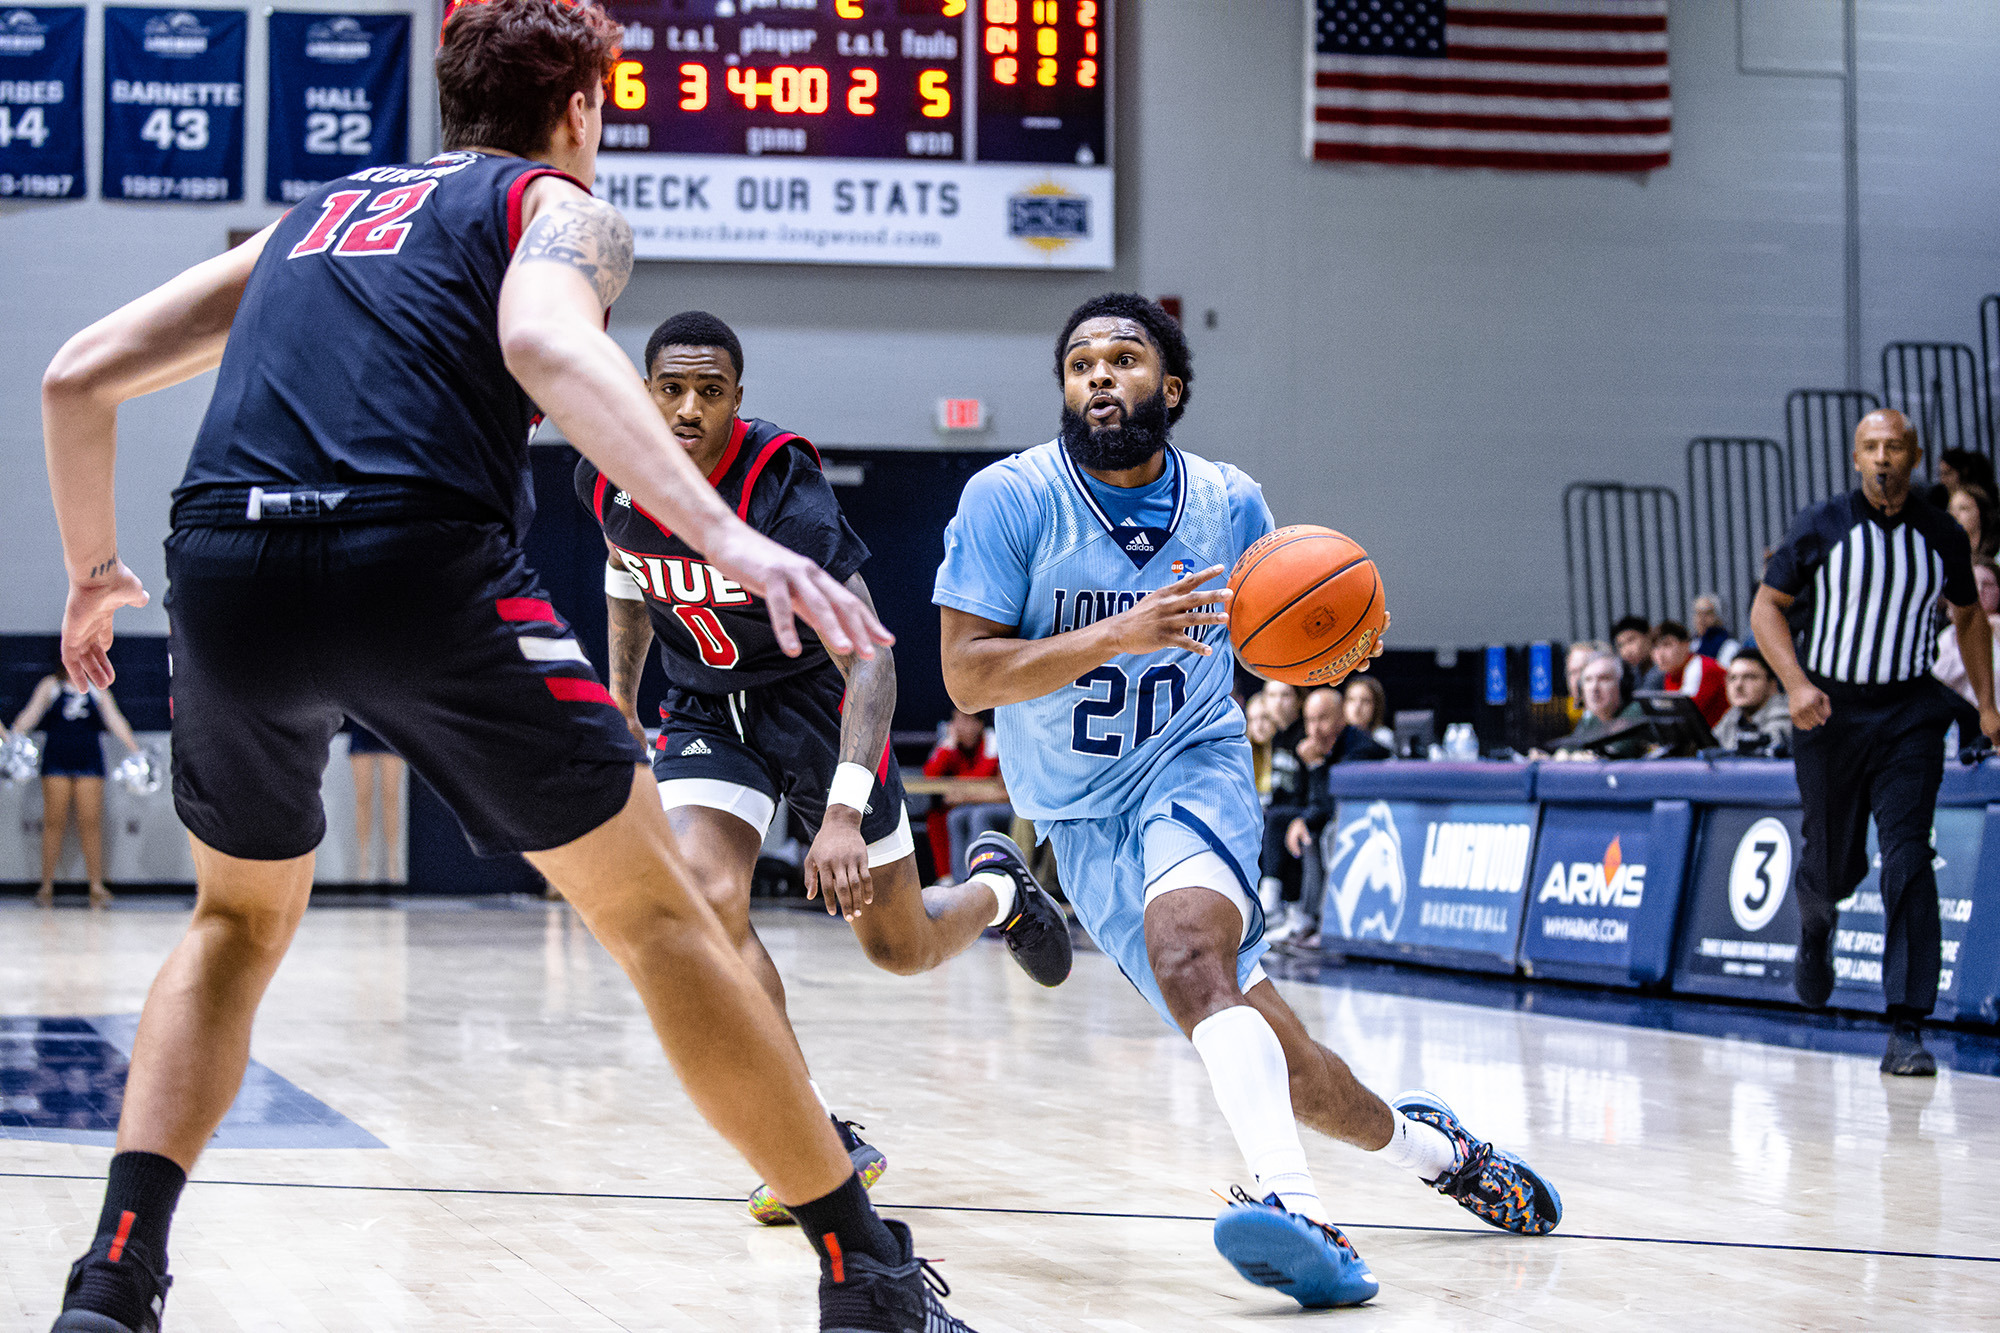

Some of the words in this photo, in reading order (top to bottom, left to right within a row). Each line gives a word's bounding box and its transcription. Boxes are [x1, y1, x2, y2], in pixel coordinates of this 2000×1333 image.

[111, 79, 242, 107] BARNETTE
[614, 60, 647, 110] 6
[677, 63, 708, 112] 3
[847, 68, 879, 116] 2
[919, 69, 951, 118] 5
[1076, 58, 1098, 88] 2
[305, 87, 372, 111] HALL
[140, 108, 210, 150] 43
[304, 113, 372, 154] 22
[287, 179, 439, 260] 12
[736, 175, 811, 213] OUR
[833, 178, 961, 218] STATS
[1125, 543, 1155, 552] adidas
[614, 546, 750, 606] SIUE
[672, 604, 740, 670] 0
[1071, 661, 1189, 759] 20
[681, 747, 712, 756] adidas
[1538, 862, 1647, 908] ARMS
[1743, 841, 1779, 912] 3
